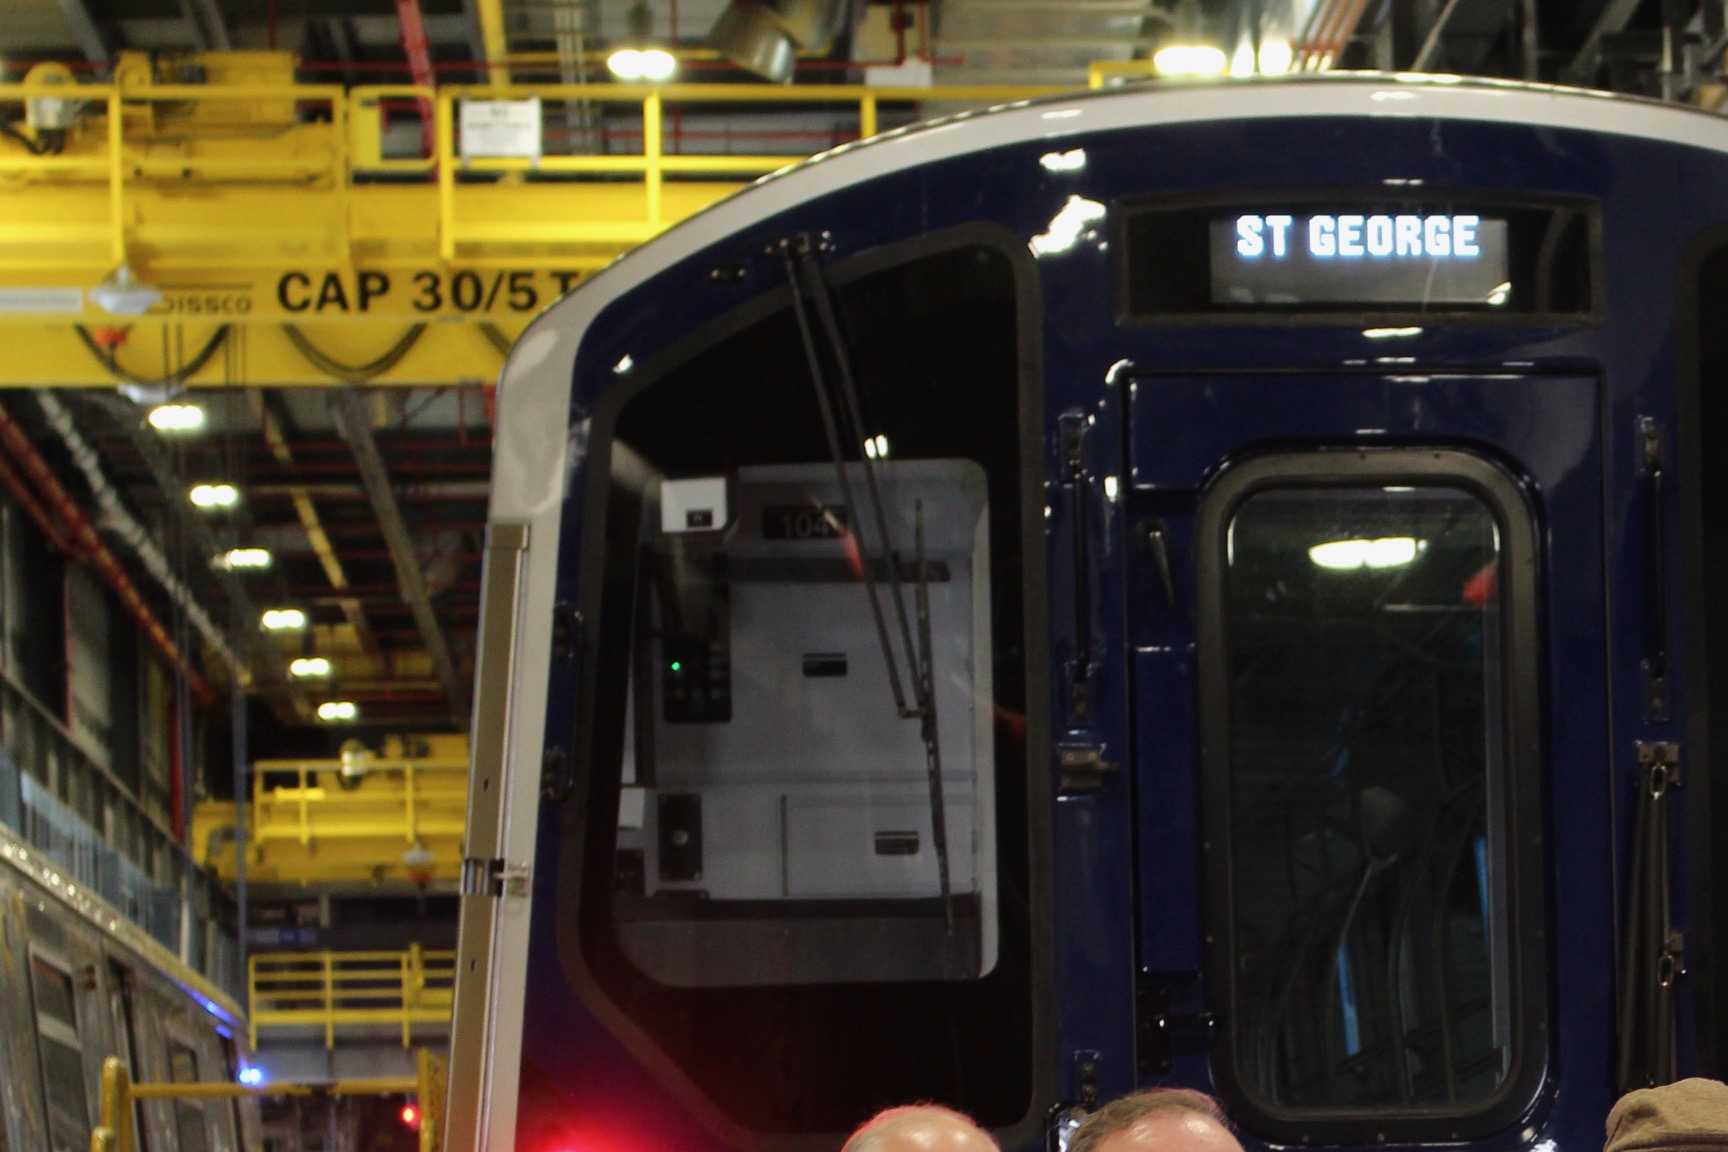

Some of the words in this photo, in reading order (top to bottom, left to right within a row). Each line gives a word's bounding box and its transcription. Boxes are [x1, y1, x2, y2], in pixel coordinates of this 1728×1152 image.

[1236, 214, 1293, 257] ST
[1308, 214, 1480, 257] GEORGE
[277, 271, 391, 312] CAP
[412, 270, 538, 313] 30/5
